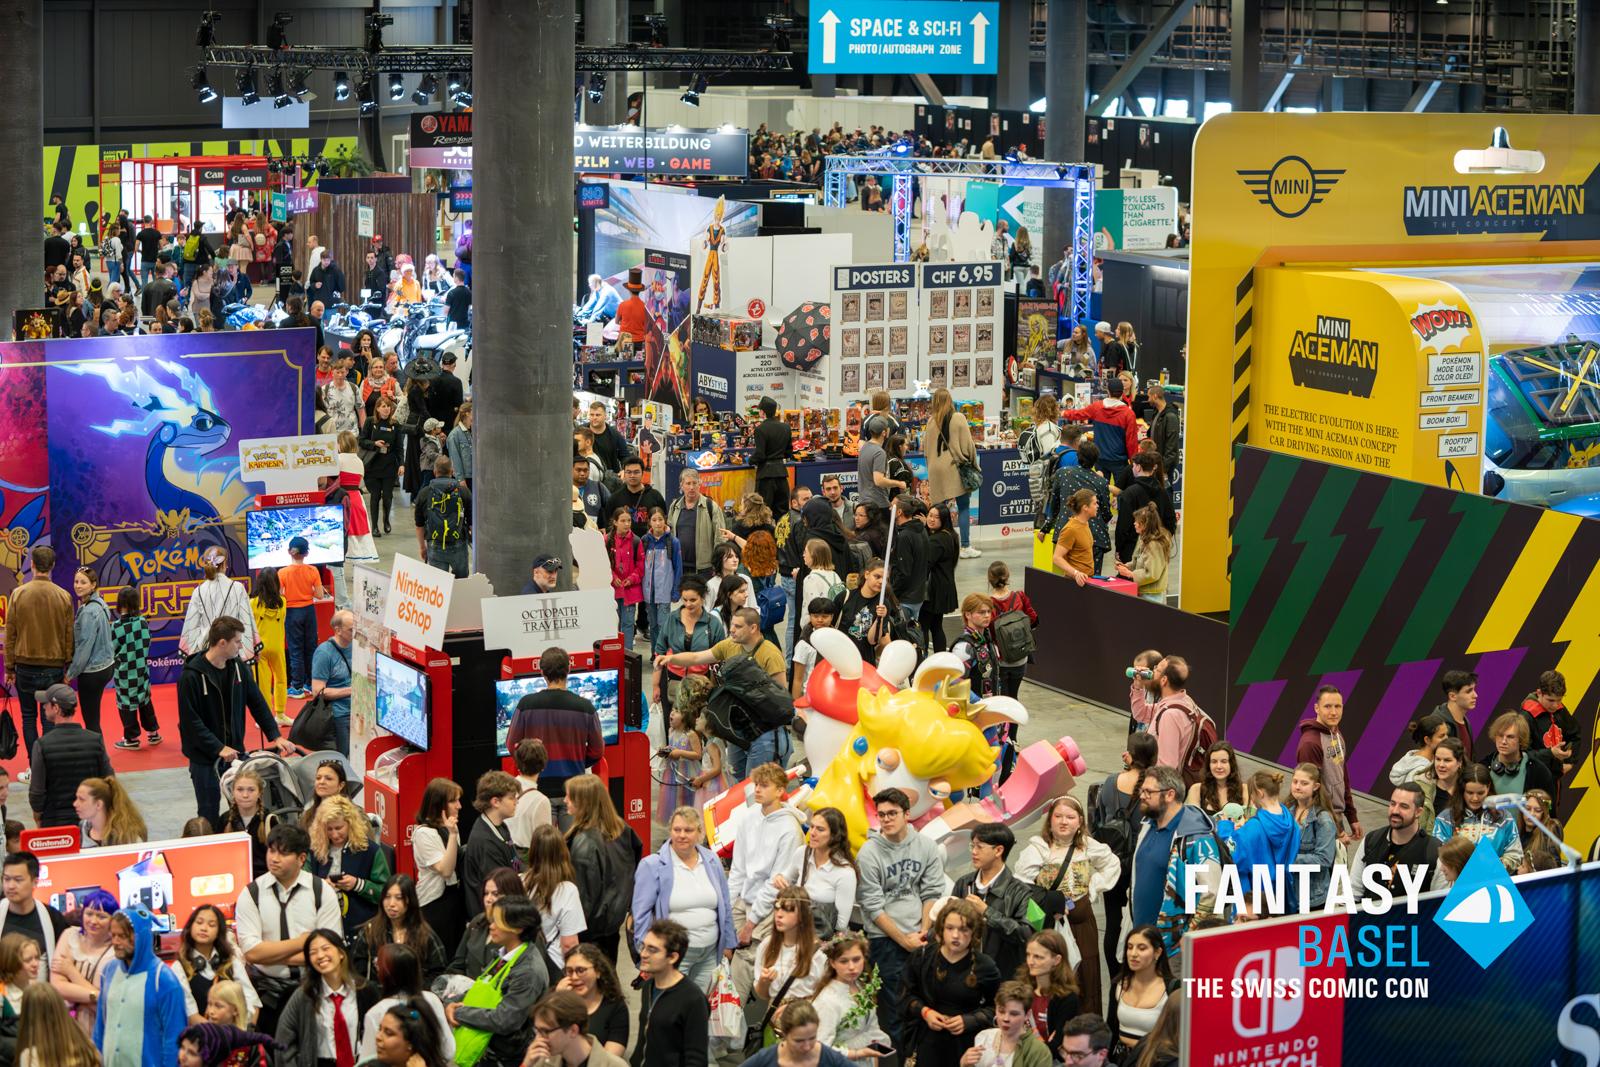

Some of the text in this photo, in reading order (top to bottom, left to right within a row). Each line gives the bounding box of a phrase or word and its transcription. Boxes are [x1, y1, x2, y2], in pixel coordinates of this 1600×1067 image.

[850, 18, 961, 37] SPACE & SCI-FI
[849, 43, 961, 55] PHOTO/AUTOGRAPH ZONE
[589, 136, 711, 150] WEITERBILDUNG
[575, 156, 711, 170] FILM WEB GAME
[232, 175, 262, 183] Canon
[1274, 179, 1309, 195] MINI
[1140, 195, 1156, 203] LESS
[1406, 188, 1585, 218] MINI ACEMAN
[1124, 203, 1165, 211] TOXICANTS
[1466, 219, 1524, 228] CONCEPT
[852, 269, 910, 286] POSTERS
[932, 265, 993, 285] CHF 6,95
[1318, 318, 1349, 339] MINI
[1410, 309, 1472, 342] WOW!
[1291, 333, 1376, 370] ACEMAN
[1442, 356, 1472, 364] POKÉMON
[1436, 365, 1453, 373] MODE
[1433, 373, 1453, 381] COLOR
[1426, 394, 1474, 403] FRONT BEAMER!
[1264, 403, 1399, 439] THE ELECTRIC EVOLUTION IS HERE:
[1426, 416, 1460, 424] BOOM BOX!
[1265, 419, 1397, 454] WITH THE MINI ACEMAN CONCEPT
[1444, 437, 1473, 445] ROOFTOP
[1269, 435, 1391, 469] CAR DRIVING PASSION AND THE
[1448, 445, 1467, 453] RACK!
[248, 456, 332, 470] KARMESIN PURPUR
[396, 569, 444, 608] Nintendo
[398, 600, 432, 635] eShop
[521, 606, 578, 620] OCTOPATH
[523, 618, 580, 632] TRAVELER
[33, 838, 70, 848] Nintendo
[1214, 1035, 1319, 1067] NINTENDO
